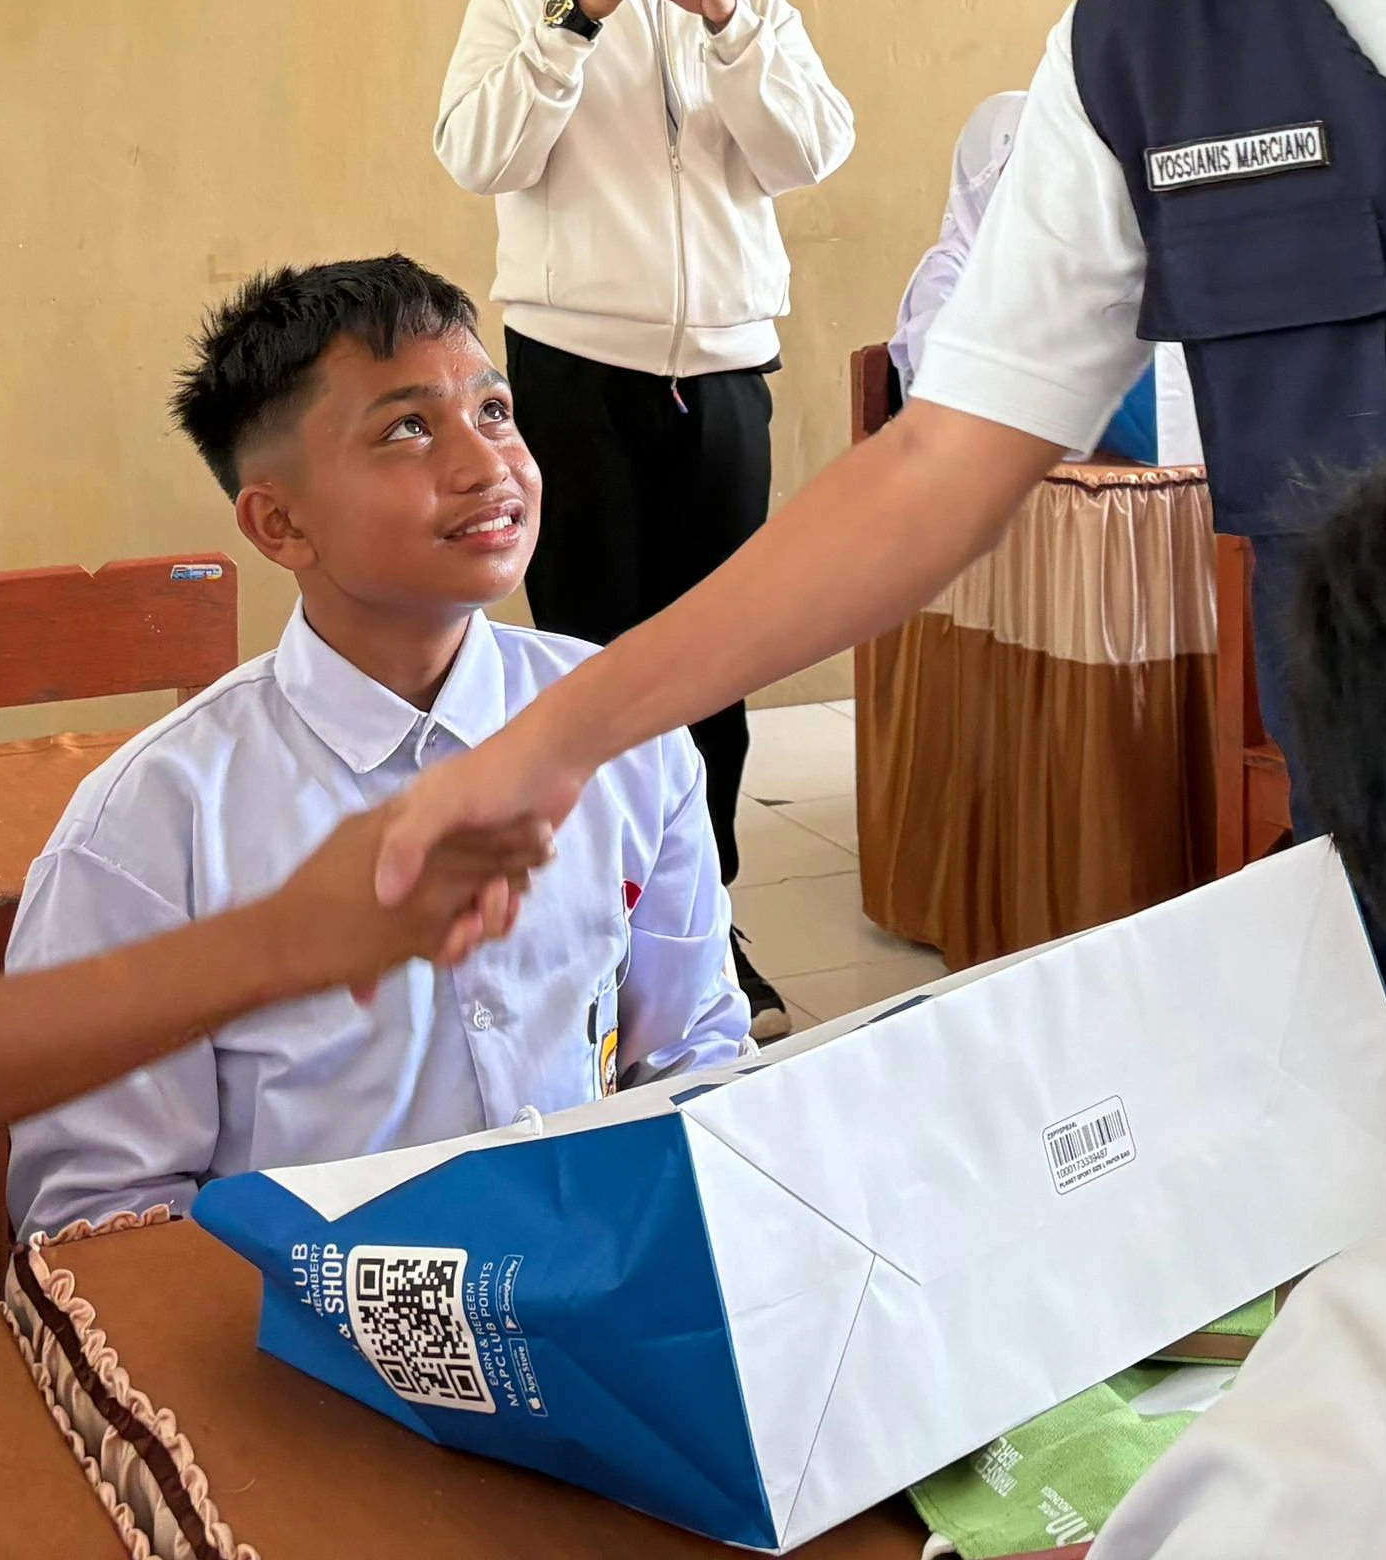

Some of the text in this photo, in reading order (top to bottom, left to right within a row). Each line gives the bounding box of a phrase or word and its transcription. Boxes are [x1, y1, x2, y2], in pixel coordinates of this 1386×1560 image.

[1155, 132, 1317, 182] YOSSIANIS MARCIANO
[1059, 1176, 1076, 1188] PLANET
[321, 1244, 344, 1314] SHOP
[478, 1262, 494, 1317] POINTS
[503, 1260, 518, 1312] Google Play
[466, 1283, 498, 1386] EARN & REDEEM
[518, 1346, 530, 1372] Store
[526, 1370, 537, 1394] App
